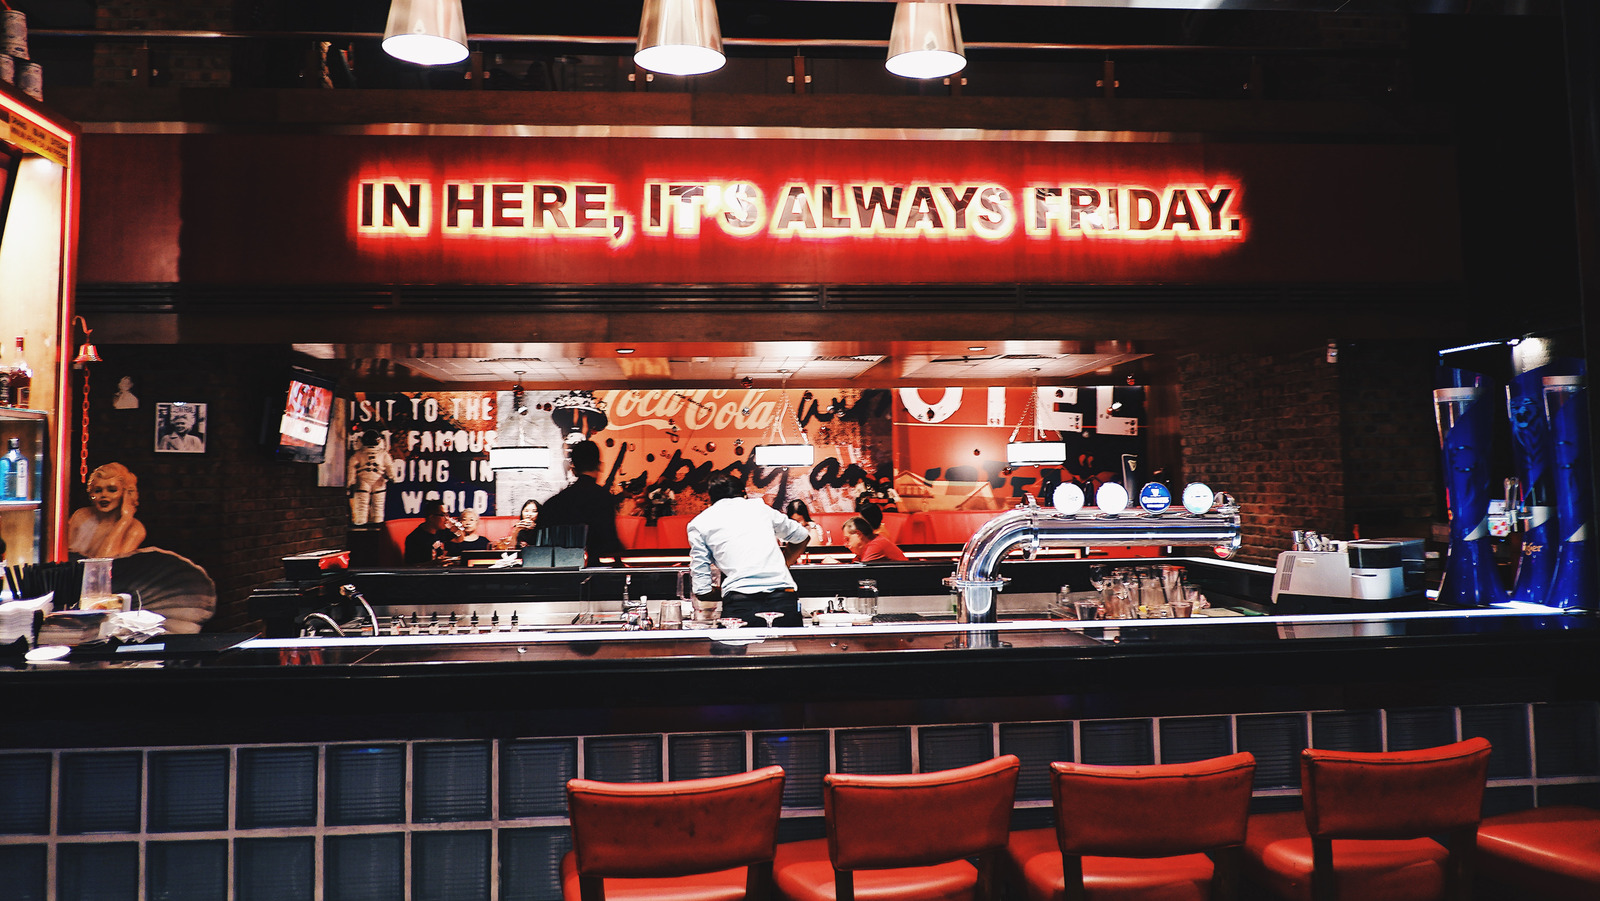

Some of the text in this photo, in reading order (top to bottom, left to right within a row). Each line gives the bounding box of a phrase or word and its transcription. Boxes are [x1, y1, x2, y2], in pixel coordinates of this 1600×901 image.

[361, 183, 1241, 239] IN HERE, IT'S ALWAYS FRIDAY.
[410, 398, 439, 422] TO
[452, 398, 493, 421] THE
[407, 430, 498, 453] FAMOUS
[470, 460, 494, 482] IN
